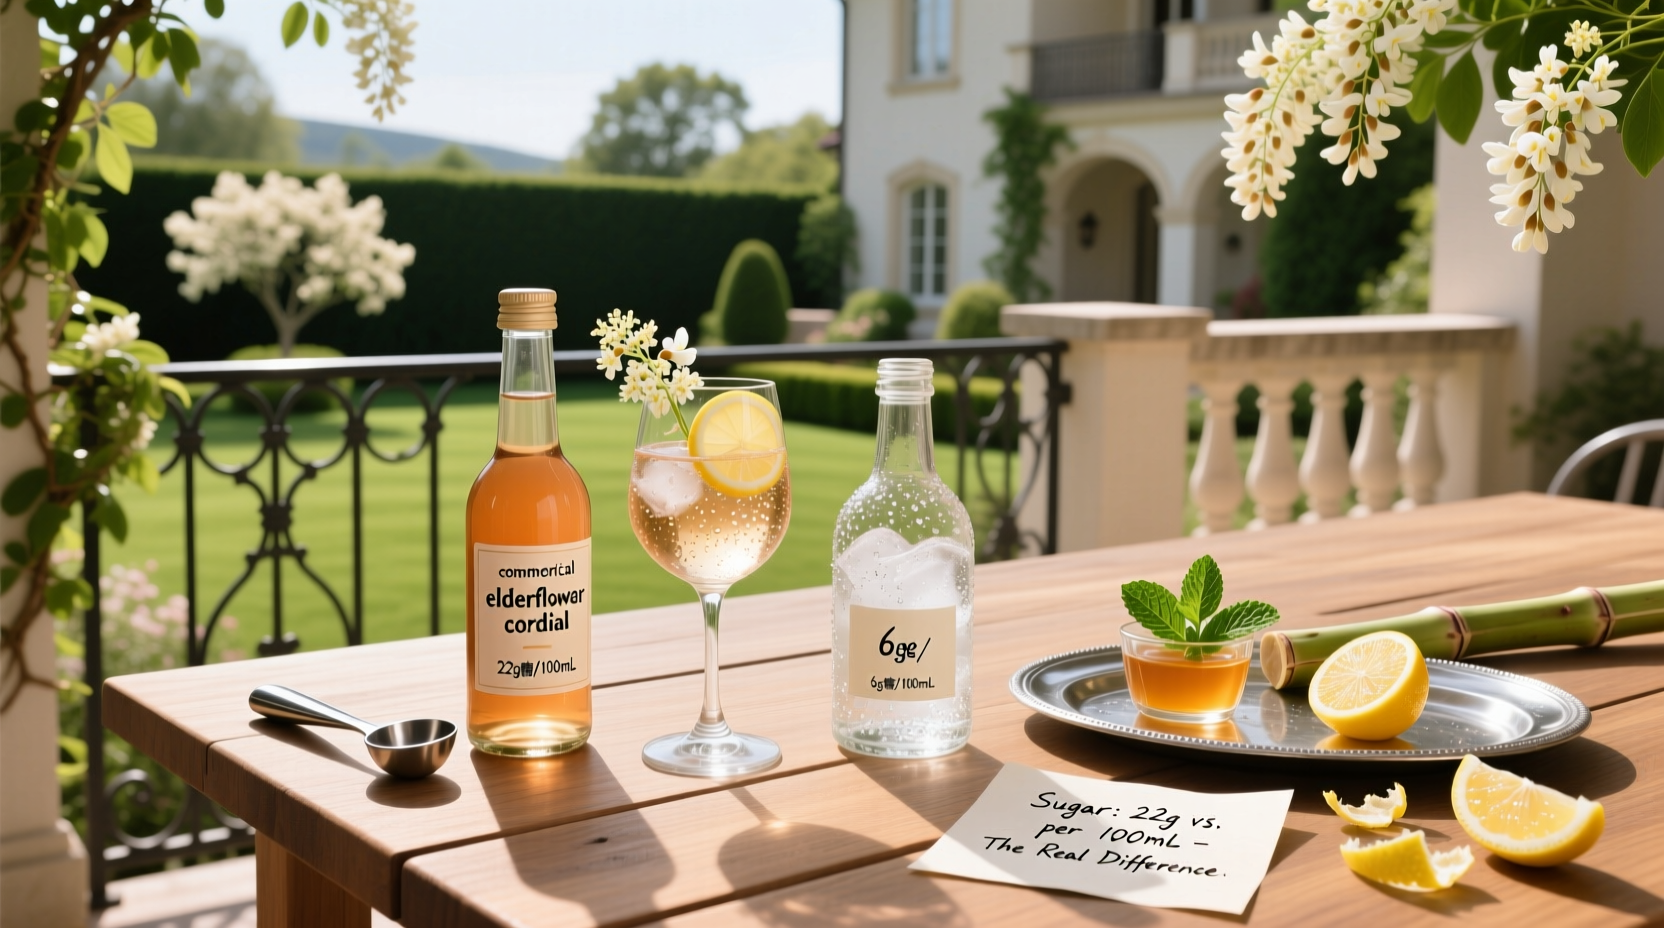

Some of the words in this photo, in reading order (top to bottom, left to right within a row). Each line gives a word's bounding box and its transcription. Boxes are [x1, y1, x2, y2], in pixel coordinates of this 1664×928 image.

[504, 610, 569, 633] cordial
[497, 656, 577, 679] 22g/100mL
[870, 675, 935, 692] 6g/100mL
[1030, 792, 1121, 819] Sugar:
[1129, 806, 1181, 830] 22g
[1192, 817, 1221, 830] vs.
[1034, 823, 1083, 839] per
[1099, 827, 1181, 848] 100mL
[984, 836, 1025, 854] The
[1036, 843, 1090, 862] Real
[1097, 850, 1226, 878] Difference.
